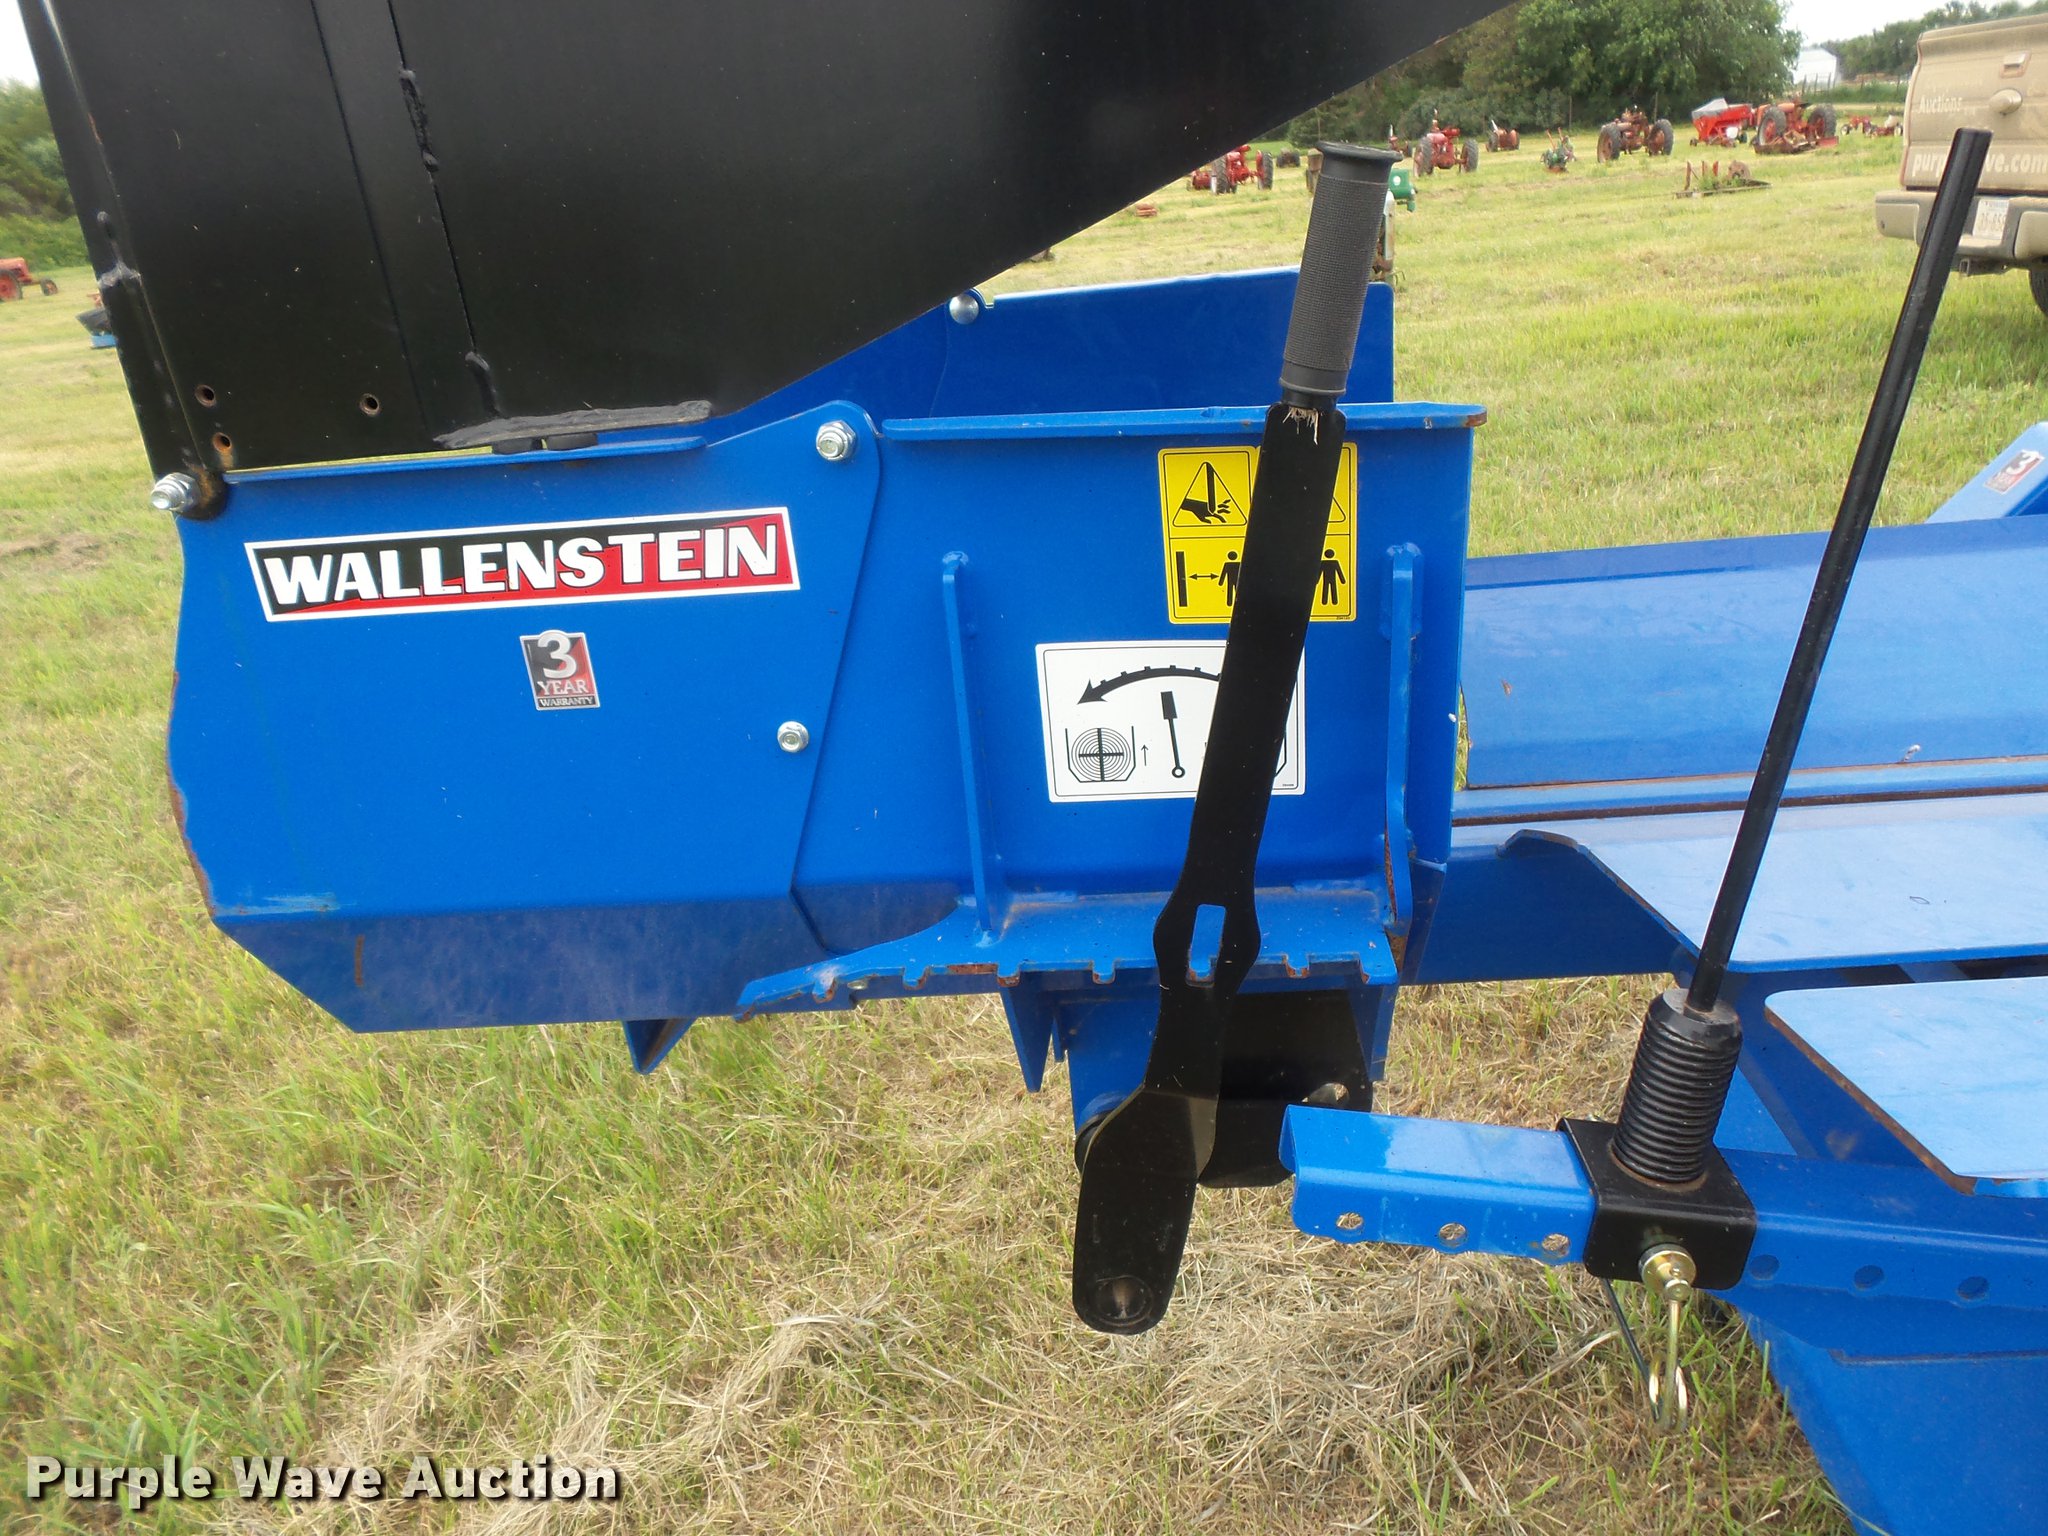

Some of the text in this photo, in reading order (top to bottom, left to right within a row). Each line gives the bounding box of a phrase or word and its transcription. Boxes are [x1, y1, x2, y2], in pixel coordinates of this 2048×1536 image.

[1919, 95, 1963, 113] Auctions
[264, 524, 778, 606] WALLENSTEIN
[538, 631, 577, 679] 3
[537, 680, 589, 695] YEAR
[539, 697, 594, 707] WARRANTY
